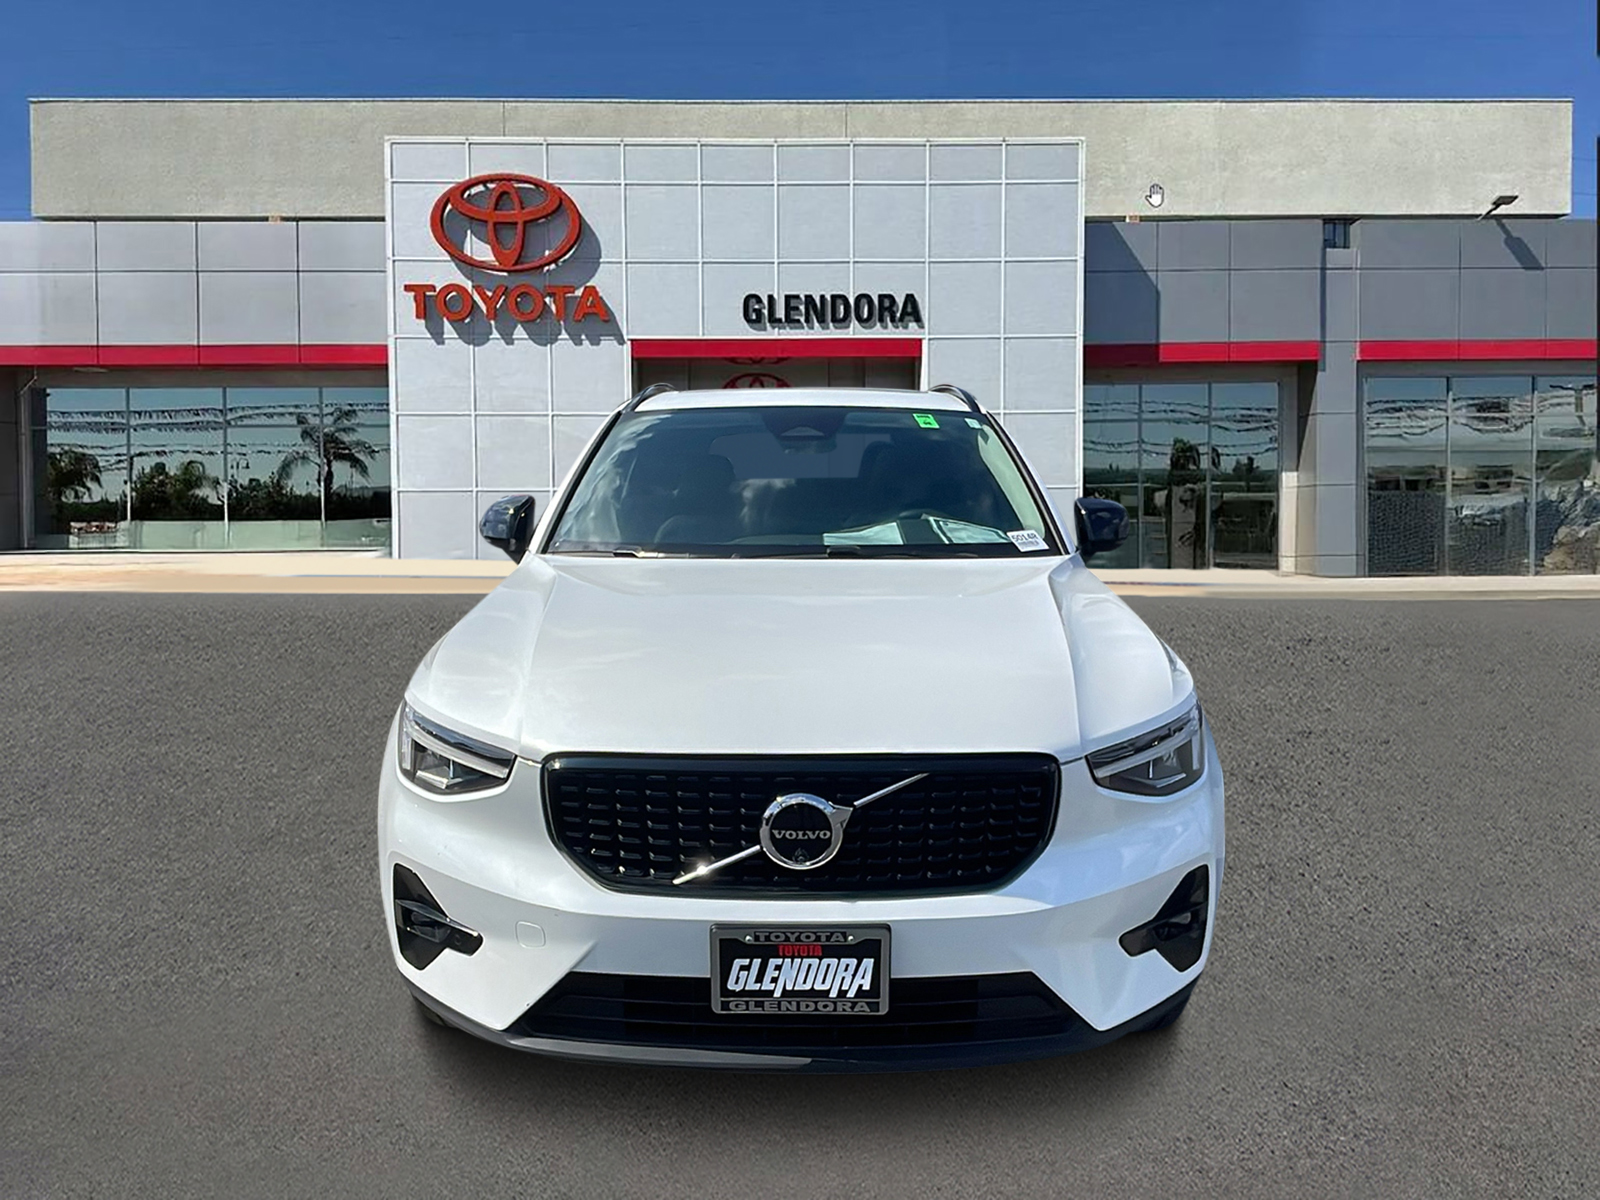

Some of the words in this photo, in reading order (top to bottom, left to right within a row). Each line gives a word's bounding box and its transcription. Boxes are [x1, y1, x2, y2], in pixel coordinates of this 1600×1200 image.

[404, 283, 610, 322] TOYOTA
[743, 293, 922, 324] GLENDORA
[772, 829, 831, 840] VOLVO
[755, 932, 845, 942] TOYOTA
[778, 945, 822, 956] TOYOTA
[727, 958, 875, 998] GLENDORA
[729, 1001, 871, 1013] GLENDORA
